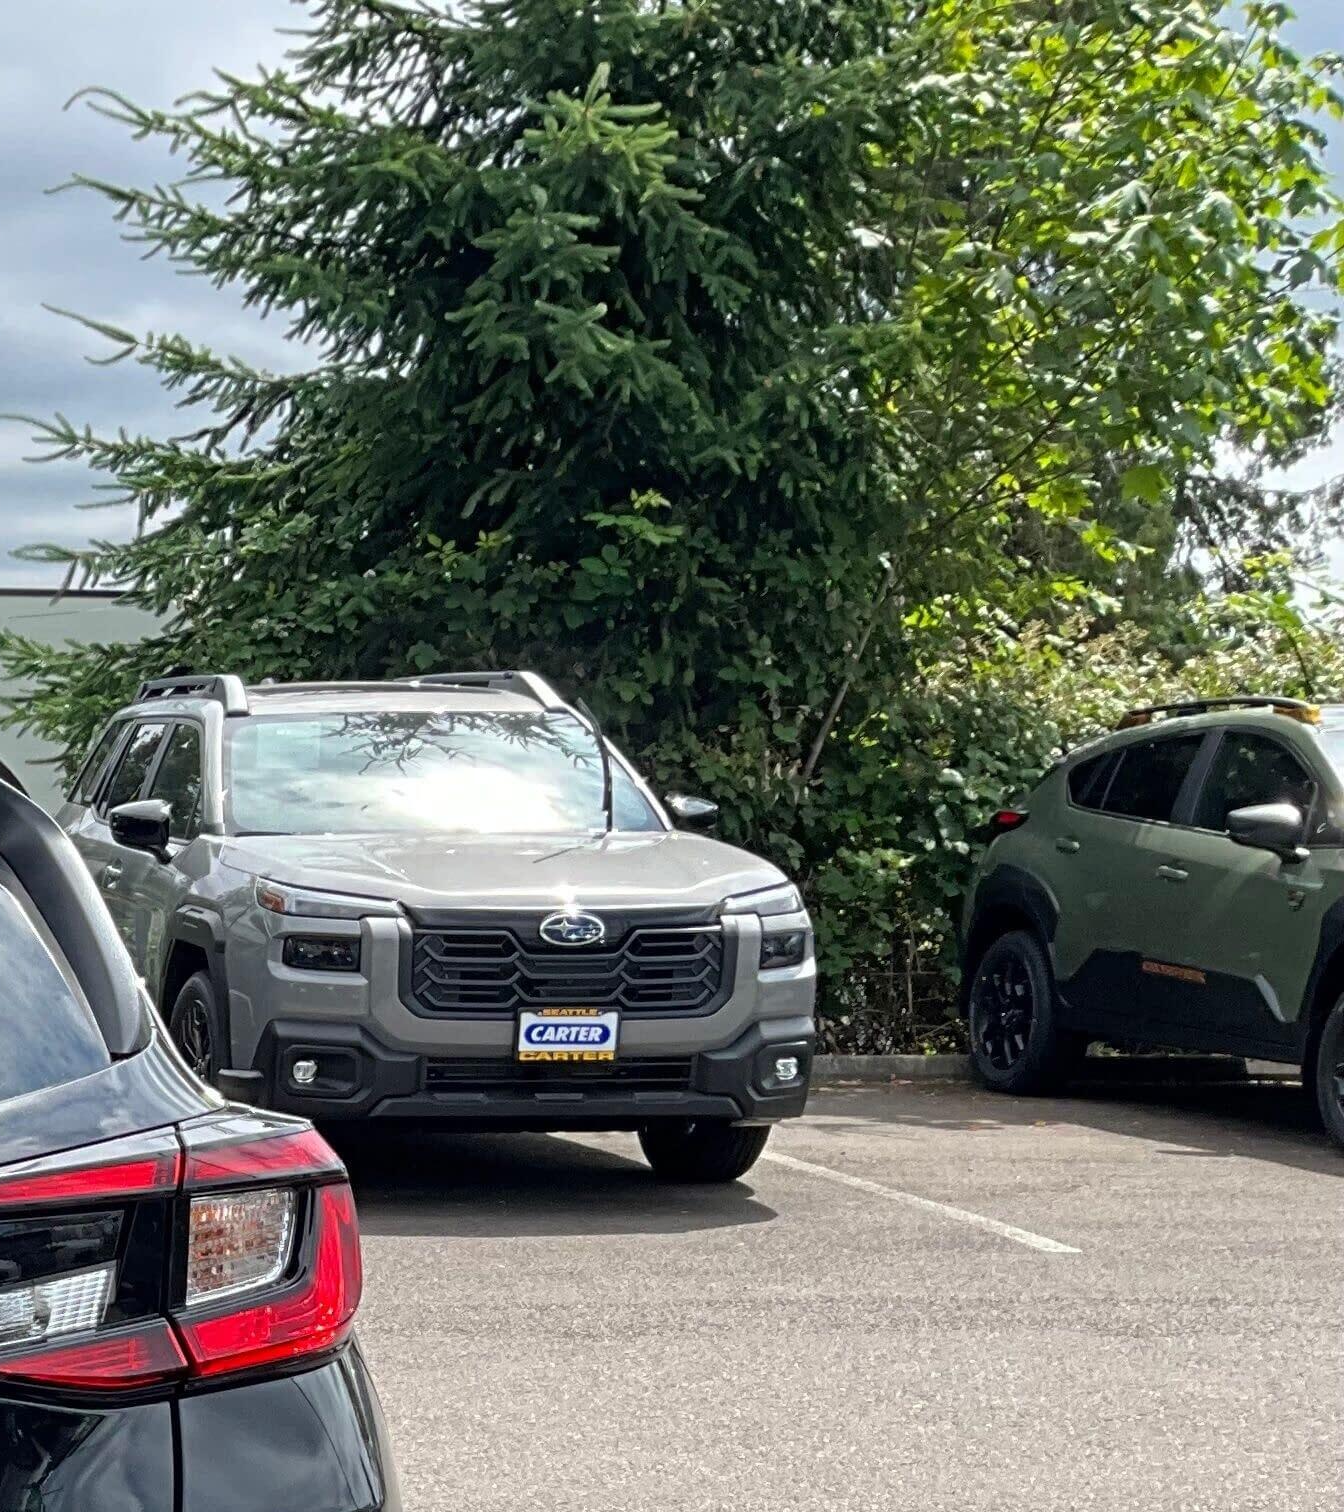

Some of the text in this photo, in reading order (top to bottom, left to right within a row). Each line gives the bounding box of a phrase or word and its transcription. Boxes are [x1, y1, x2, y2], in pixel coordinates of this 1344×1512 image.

[542, 1007, 599, 1017] SEATTLE
[530, 1025, 603, 1042] CARTER
[518, 1050, 615, 1061] CARTER
